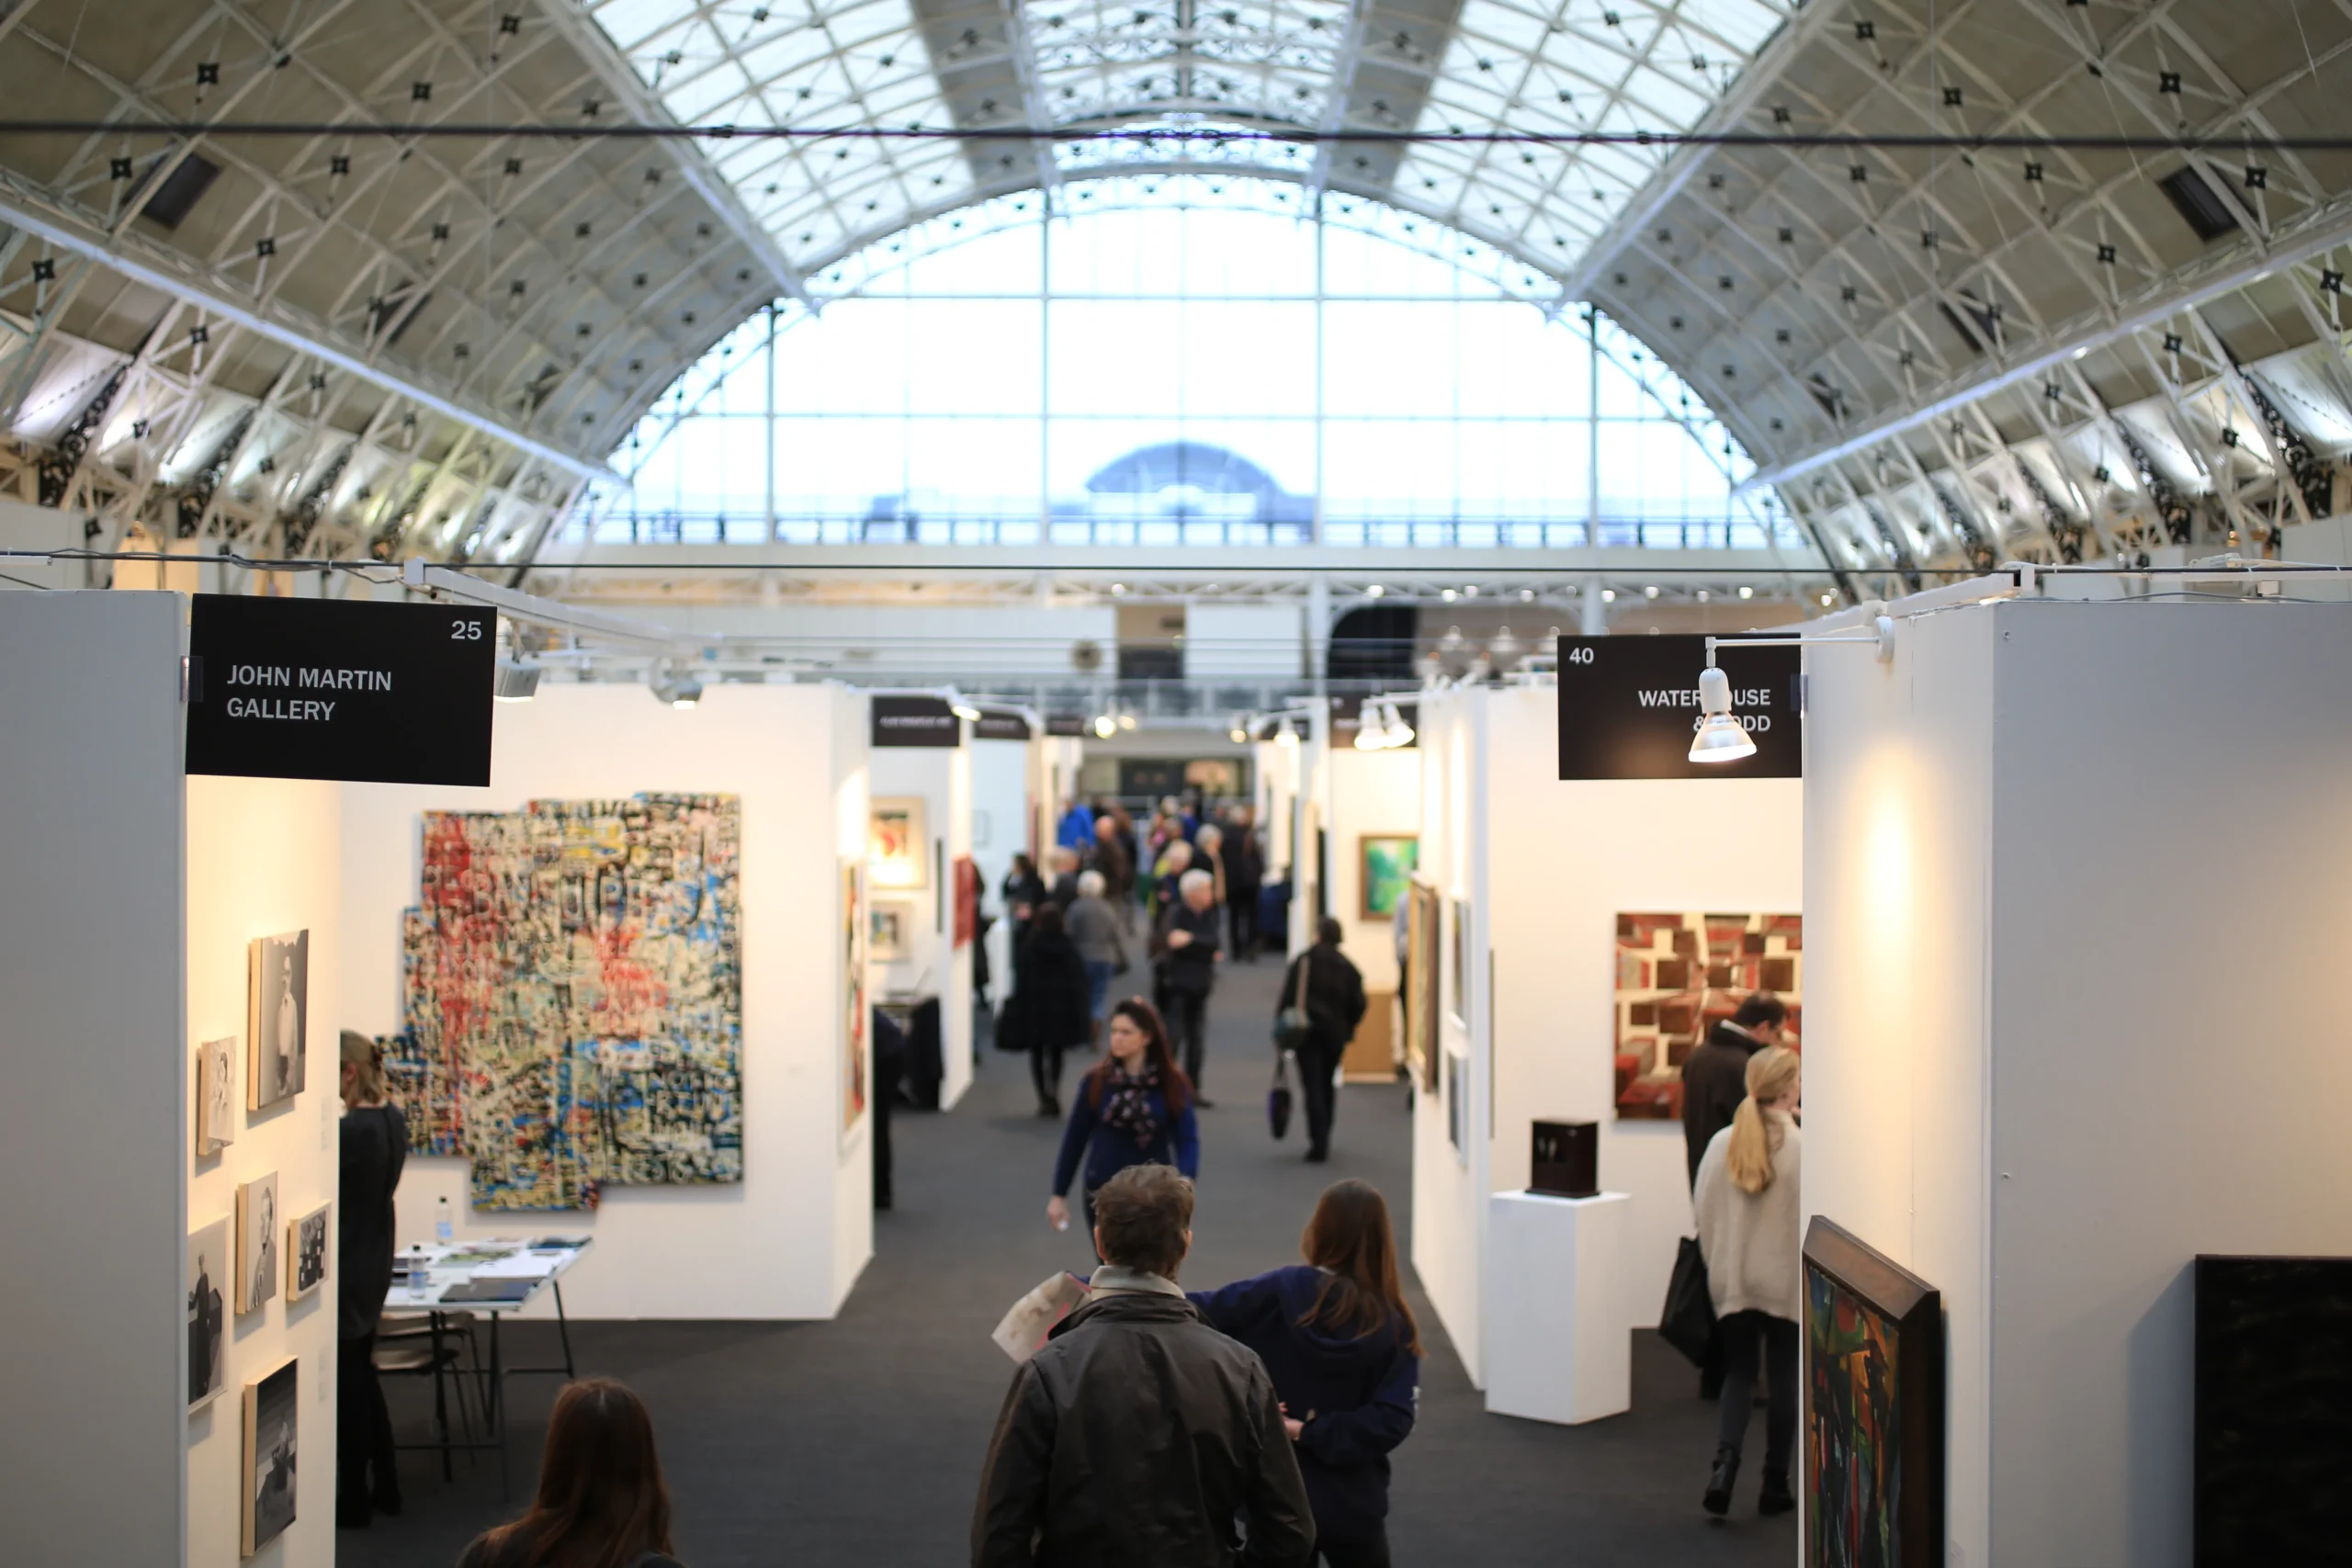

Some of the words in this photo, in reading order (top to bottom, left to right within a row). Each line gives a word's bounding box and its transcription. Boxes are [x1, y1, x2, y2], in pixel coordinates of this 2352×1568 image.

[450, 620, 482, 640] 25
[1568, 648, 1595, 664] 40
[227, 664, 290, 687] JOHN
[299, 667, 392, 691] MARTIN
[1638, 689, 1771, 707] WATERUSE
[227, 697, 336, 721] GALLERY
[1692, 715, 1705, 732] &
